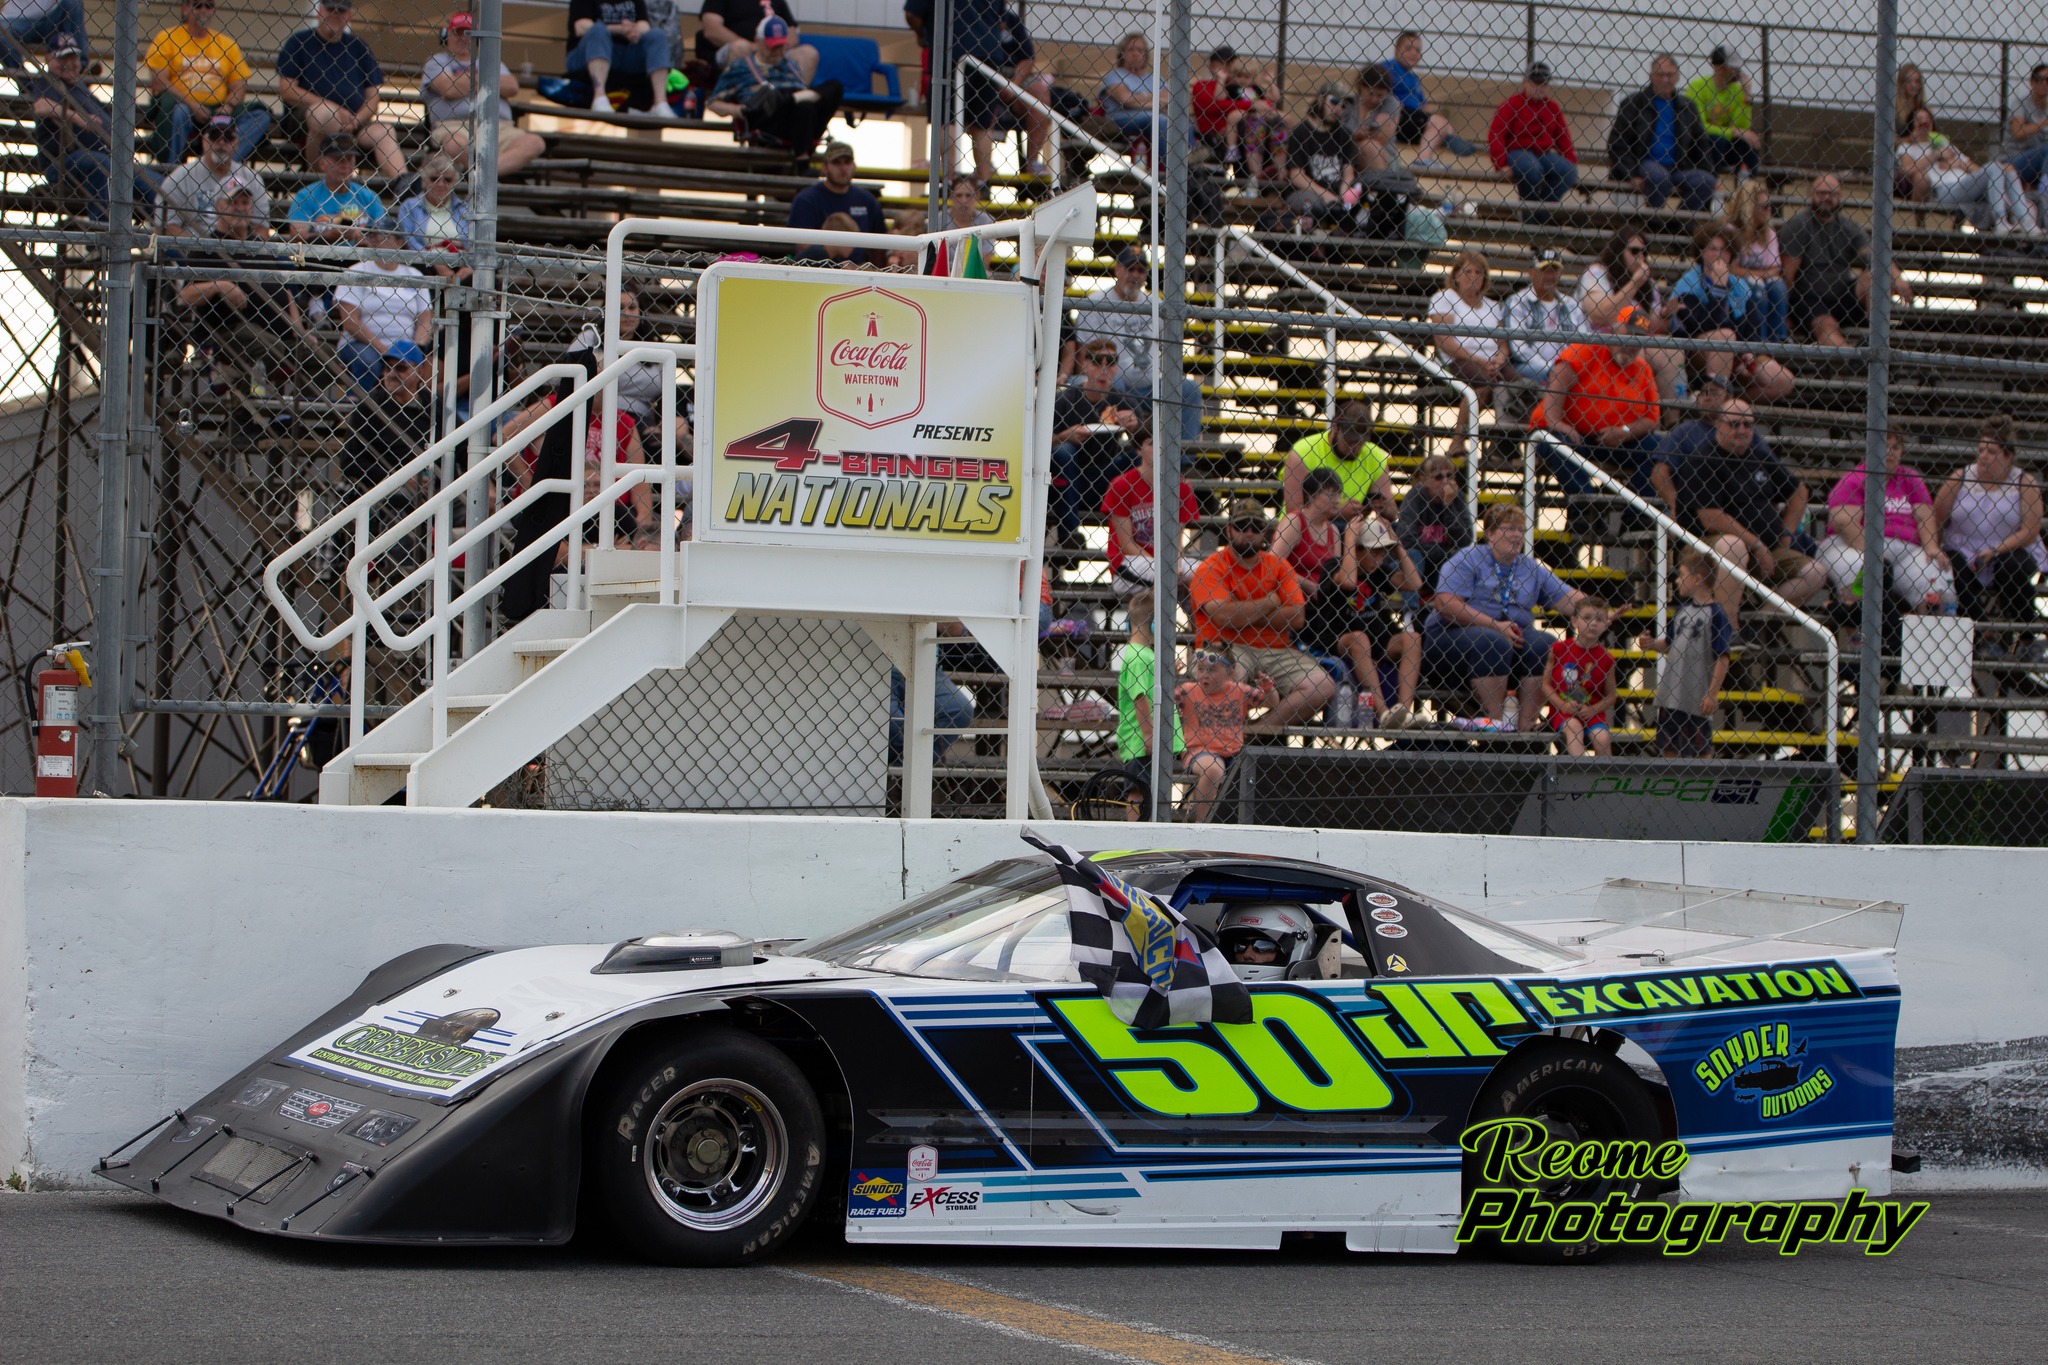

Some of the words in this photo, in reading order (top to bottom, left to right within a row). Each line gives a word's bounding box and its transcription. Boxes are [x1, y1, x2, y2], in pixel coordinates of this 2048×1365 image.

[830, 339, 914, 371] Coca-Cola
[844, 373, 899, 387] WATERTOWN
[856, 396, 862, 405] N
[879, 397, 885, 406] Y
[724, 417, 1009, 481] 4-BANGER
[912, 424, 994, 442] PRESENTS
[724, 472, 1012, 533] NATIONALS
[1528, 967, 1851, 1017] EXCAVATION
[312, 1049, 340, 1063] CUSTOM
[340, 1055, 357, 1066] DUCT
[332, 1024, 506, 1077] CREEKSIDE
[1054, 993, 1392, 1115] 50
[1695, 1024, 1789, 1091] SNYDER
[617, 1066, 676, 1140] RACER
[1500, 1058, 1604, 1113] AMERICAN
[1762, 1069, 1833, 1117] OUTDOORS
[742, 1143, 821, 1255] AMERICAN
[850, 1208, 876, 1216] RACE
[876, 1207, 906, 1216] FUELS
[855, 1184, 902, 1194] SUNOCO
[910, 1186, 980, 1217] EXCESS
